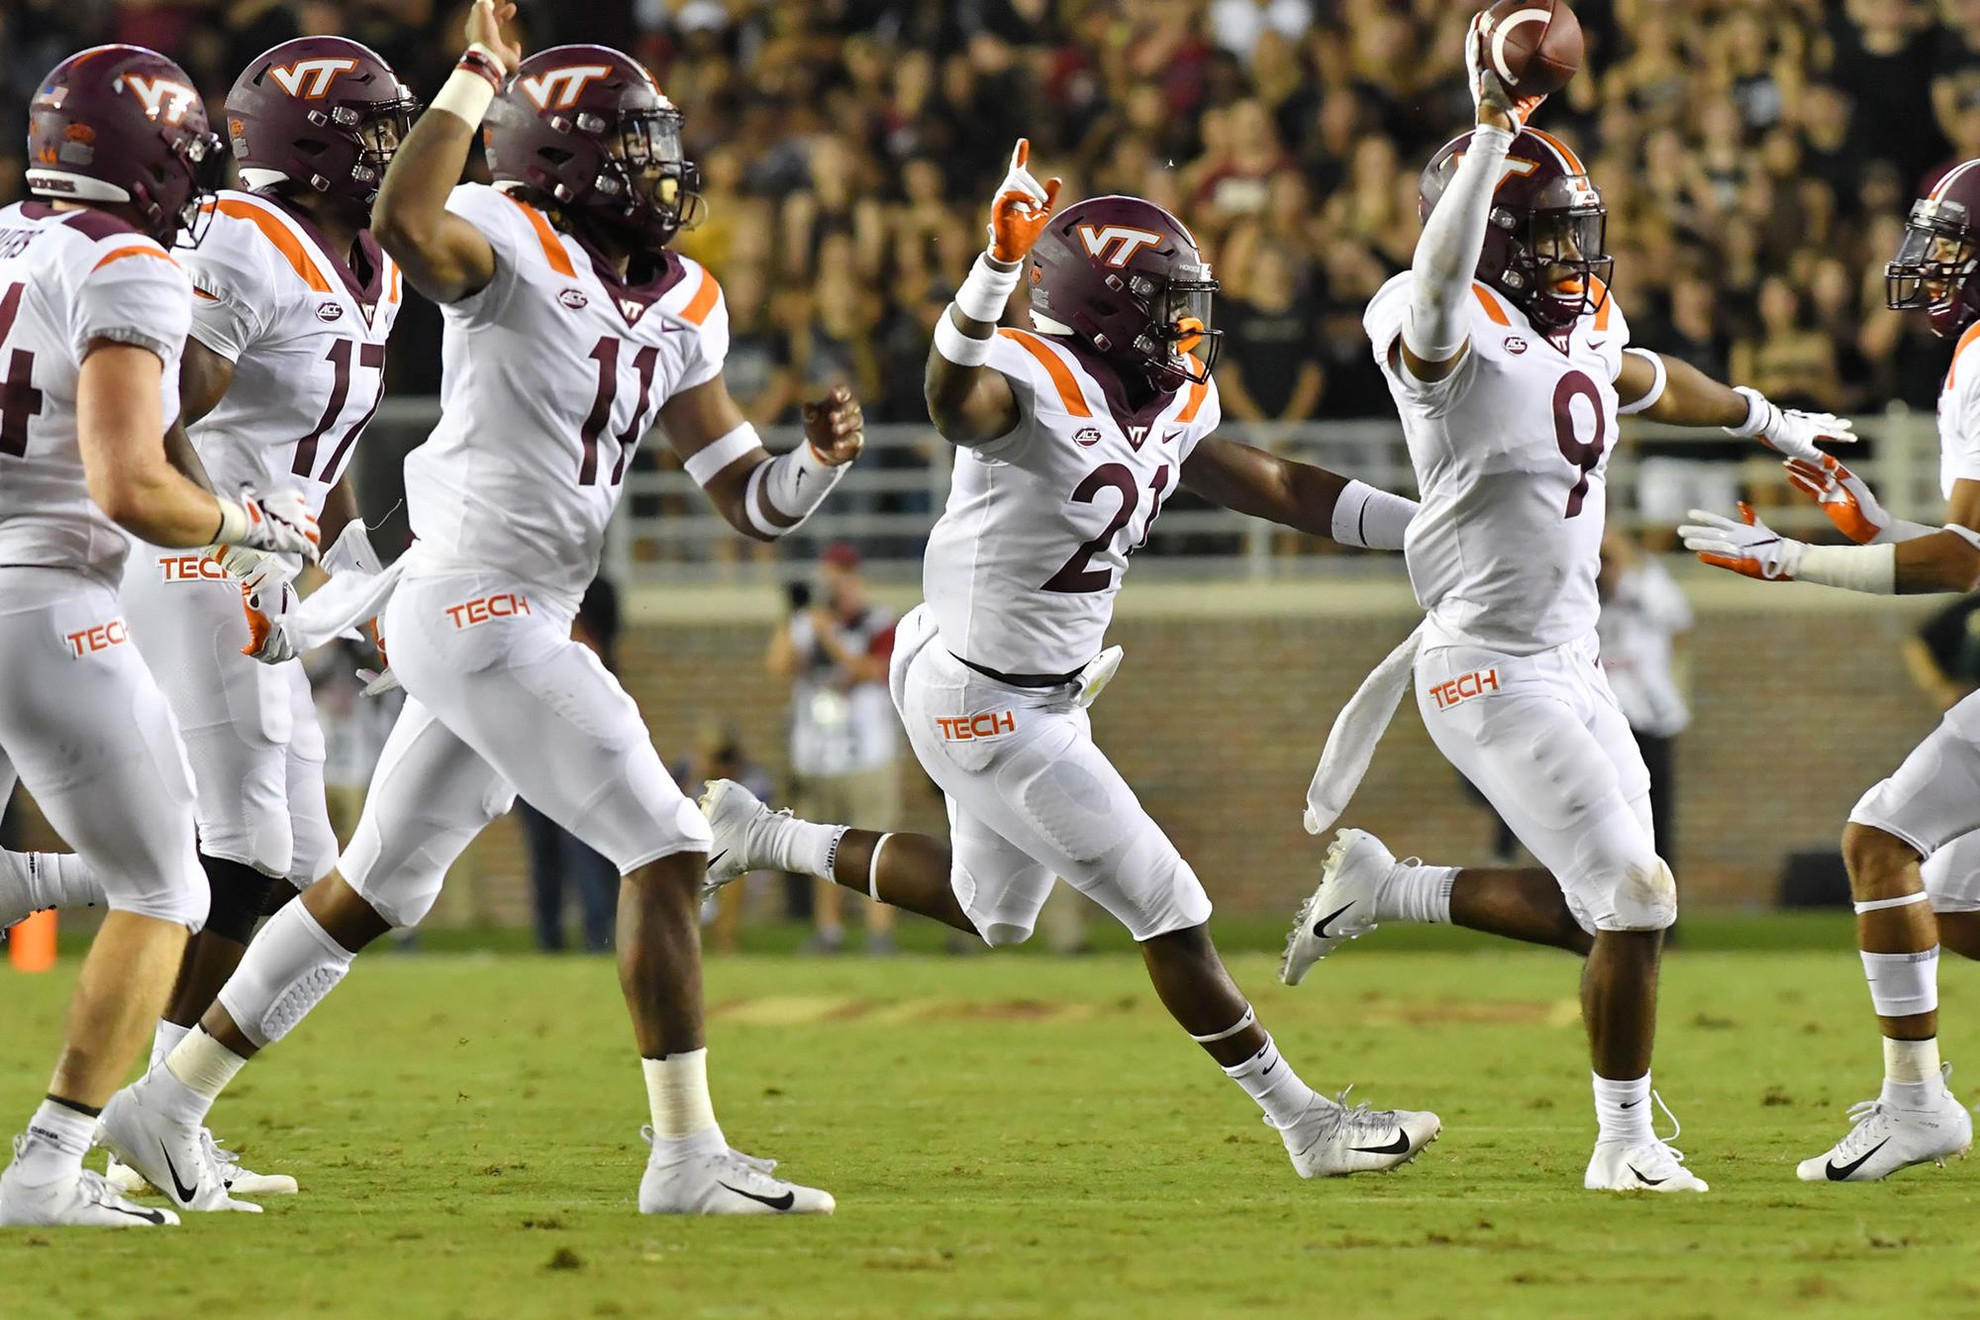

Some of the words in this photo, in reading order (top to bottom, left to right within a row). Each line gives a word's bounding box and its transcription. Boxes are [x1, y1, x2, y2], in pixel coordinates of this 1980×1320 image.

[269, 57, 361, 100] VT
[519, 64, 613, 113] VT
[1076, 224, 1165, 269] VT
[619, 299, 644, 320] VT
[291, 338, 386, 484] 17
[578, 335, 660, 487] 11
[1076, 429, 1100, 441] ACC
[1126, 425, 1149, 444] VT
[1552, 369, 1606, 519] 9
[1040, 462, 1170, 593] 21
[446, 594, 531, 629] TECH
[67, 621, 131, 656] TEC
[1429, 668, 1499, 710] TECH
[936, 710, 1016, 740] TECH
